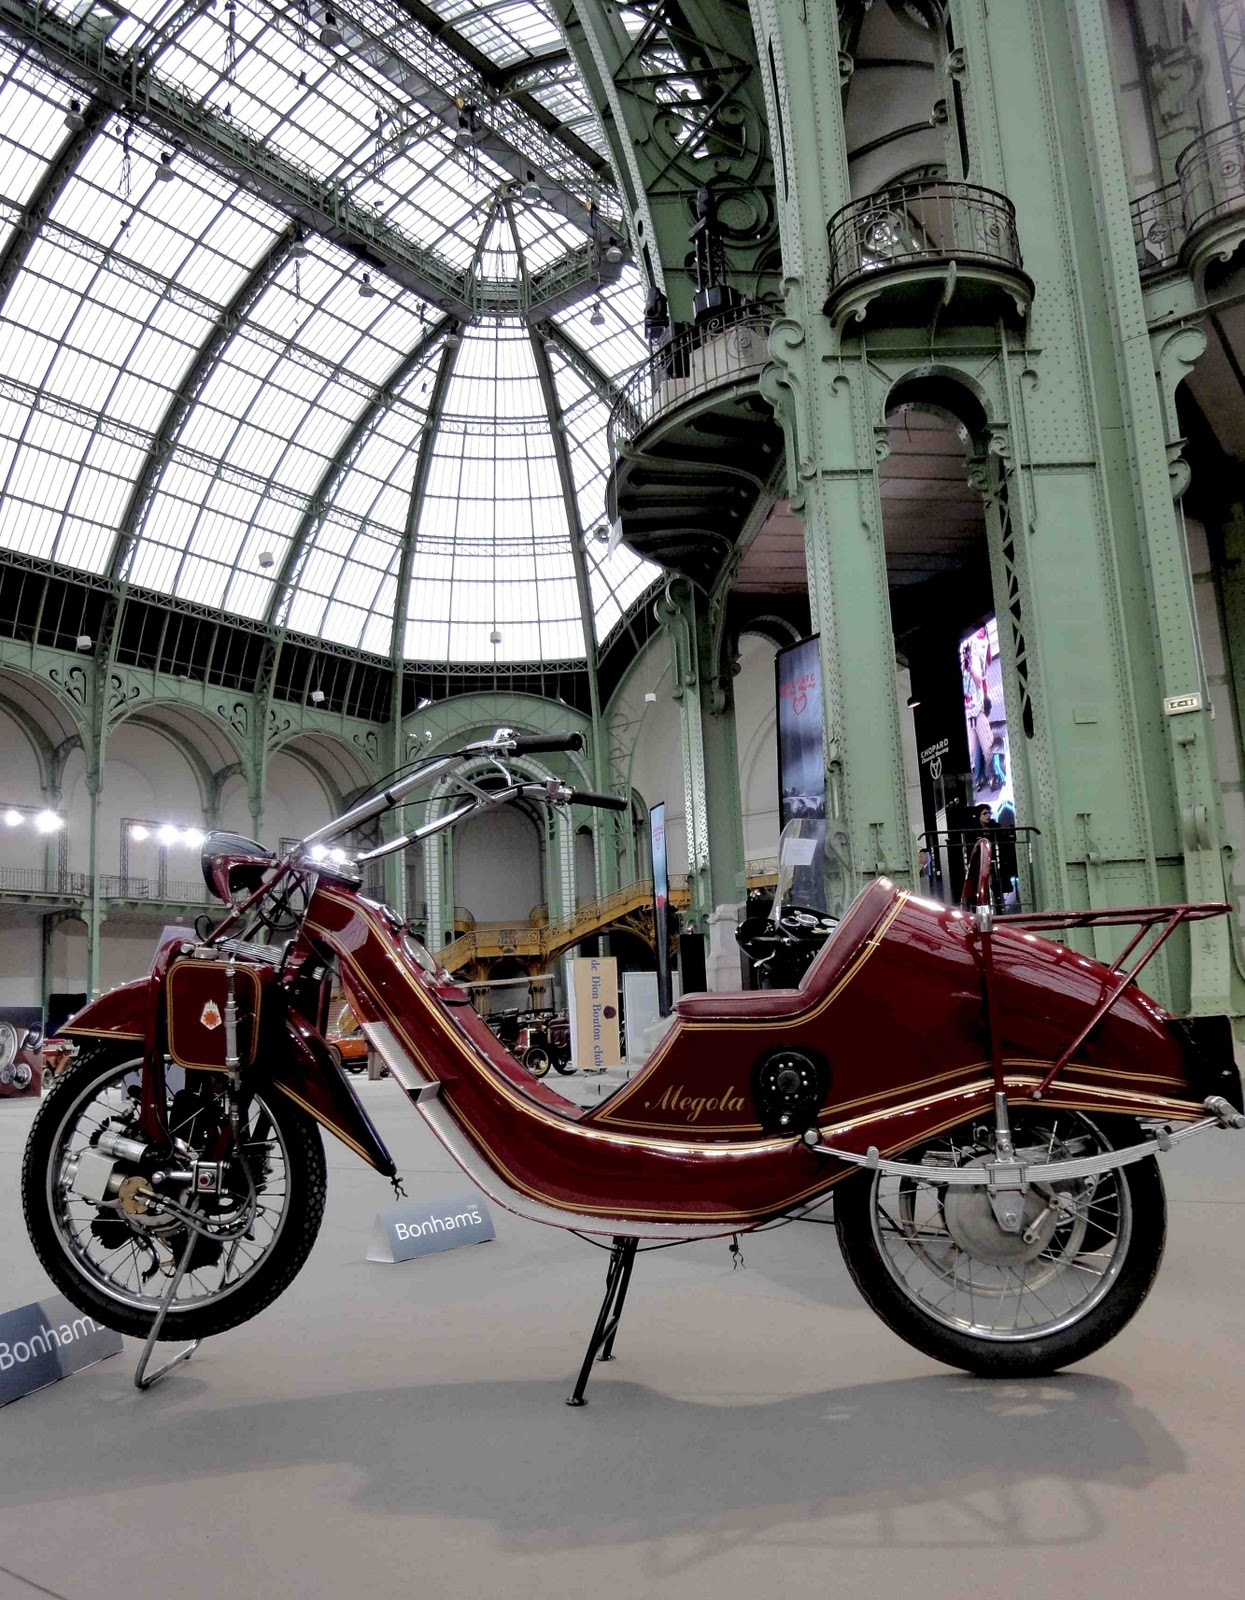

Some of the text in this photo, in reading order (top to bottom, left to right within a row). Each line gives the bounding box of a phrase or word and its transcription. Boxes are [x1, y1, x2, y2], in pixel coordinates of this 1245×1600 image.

[921, 738, 949, 758] CHOPARD
[591, 959, 604, 1066] de Dion Bouton club
[644, 1085, 745, 1122] Megola
[394, 1210, 482, 1241] Bonhams
[0, 1315, 106, 1371] Bonham
